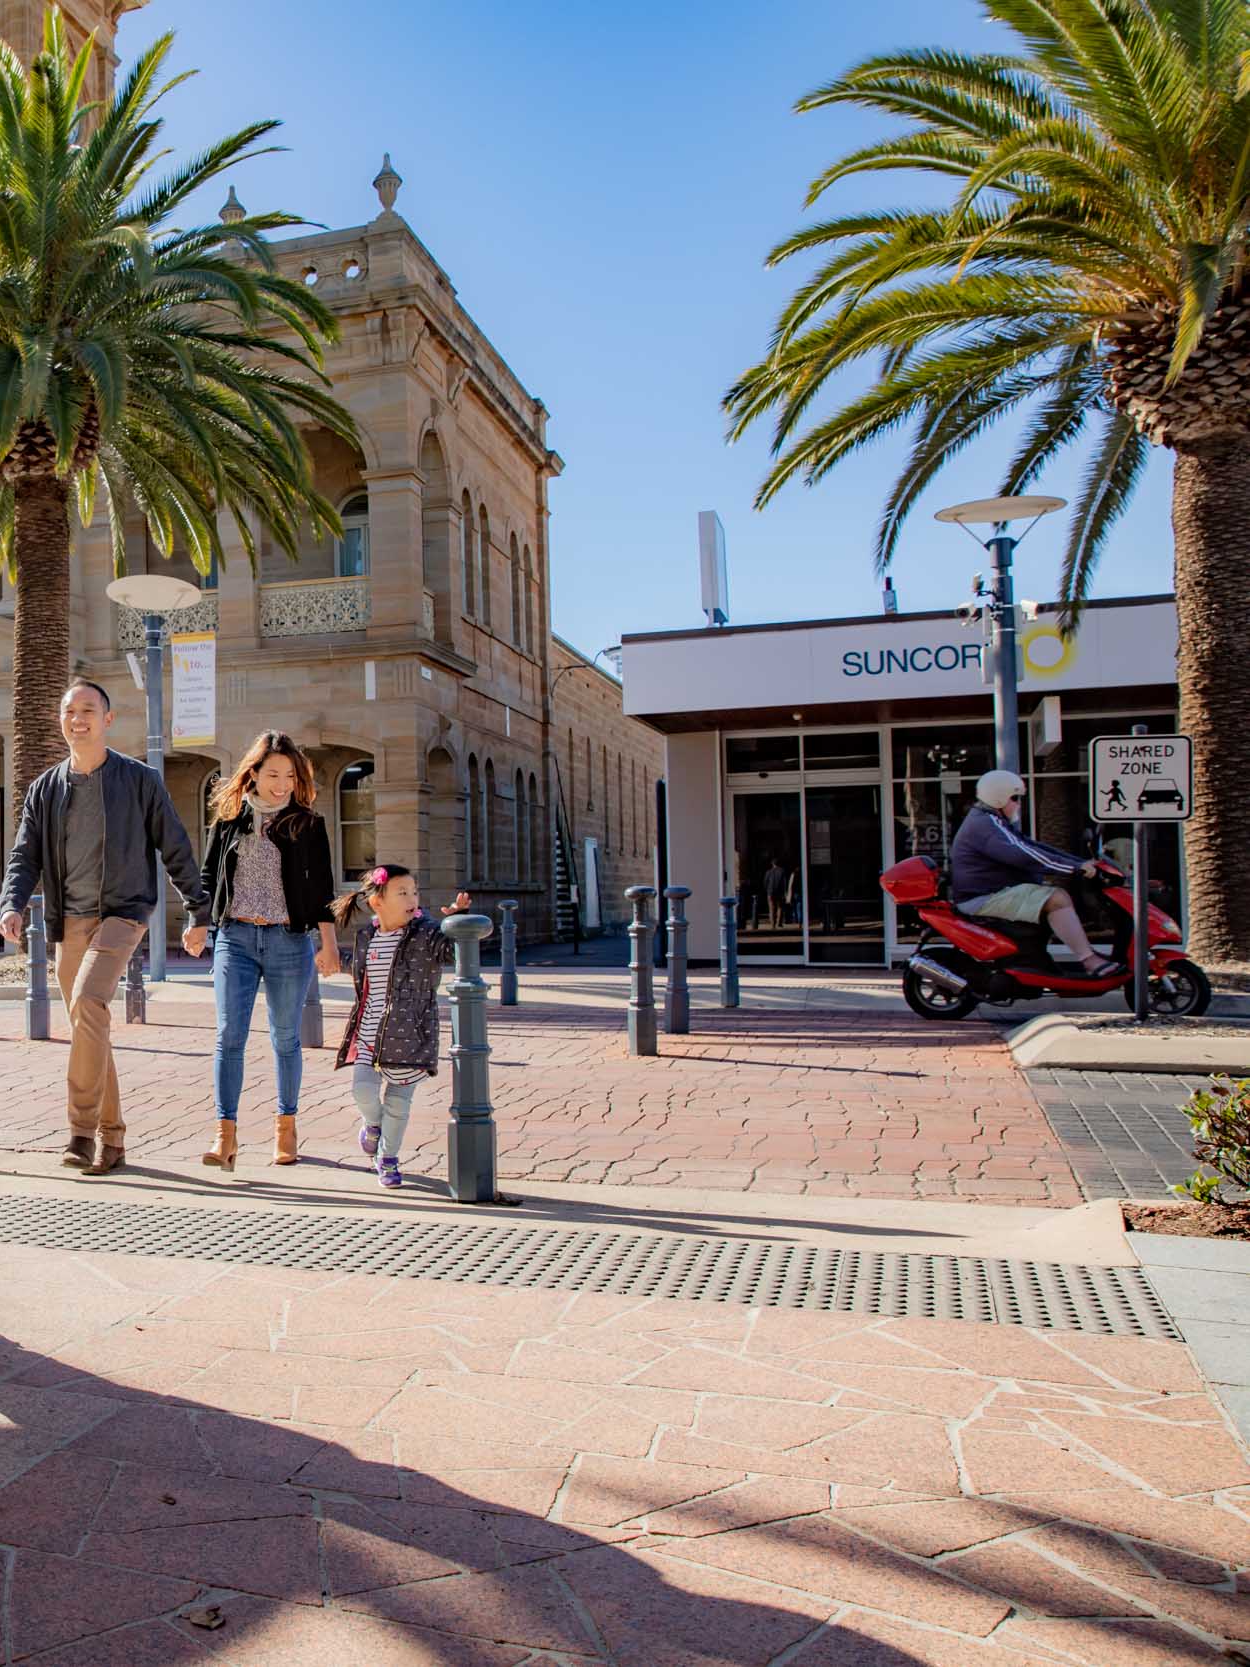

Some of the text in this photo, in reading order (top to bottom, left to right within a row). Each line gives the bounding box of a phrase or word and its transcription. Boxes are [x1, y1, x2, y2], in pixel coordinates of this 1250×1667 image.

[842, 643, 989, 676] SUNCOR
[1109, 745, 1174, 758] SHARED
[1120, 762, 1162, 775] ZONE
